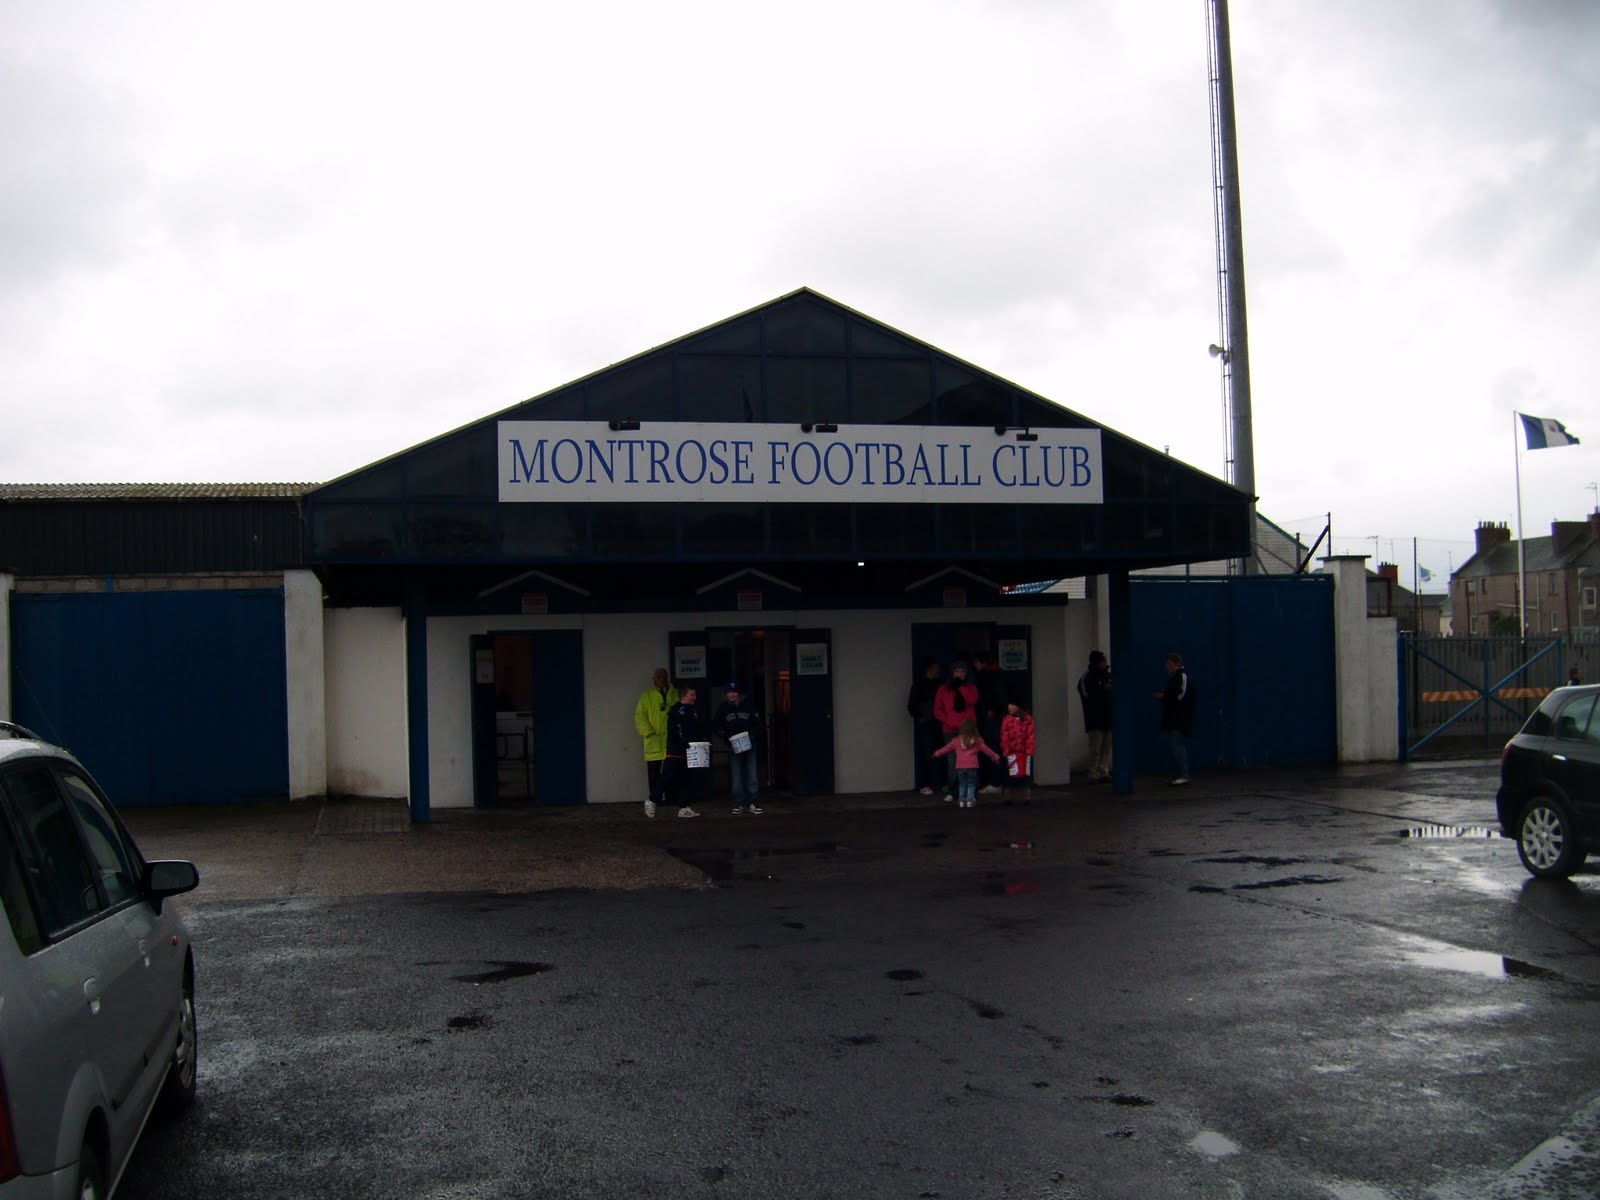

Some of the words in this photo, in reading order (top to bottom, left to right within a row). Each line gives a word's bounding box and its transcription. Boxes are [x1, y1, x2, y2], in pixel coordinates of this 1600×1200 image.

[508, 439, 754, 484] MONTROSE
[767, 441, 981, 486] FOOTBALL
[992, 444, 1092, 487] CLUB
